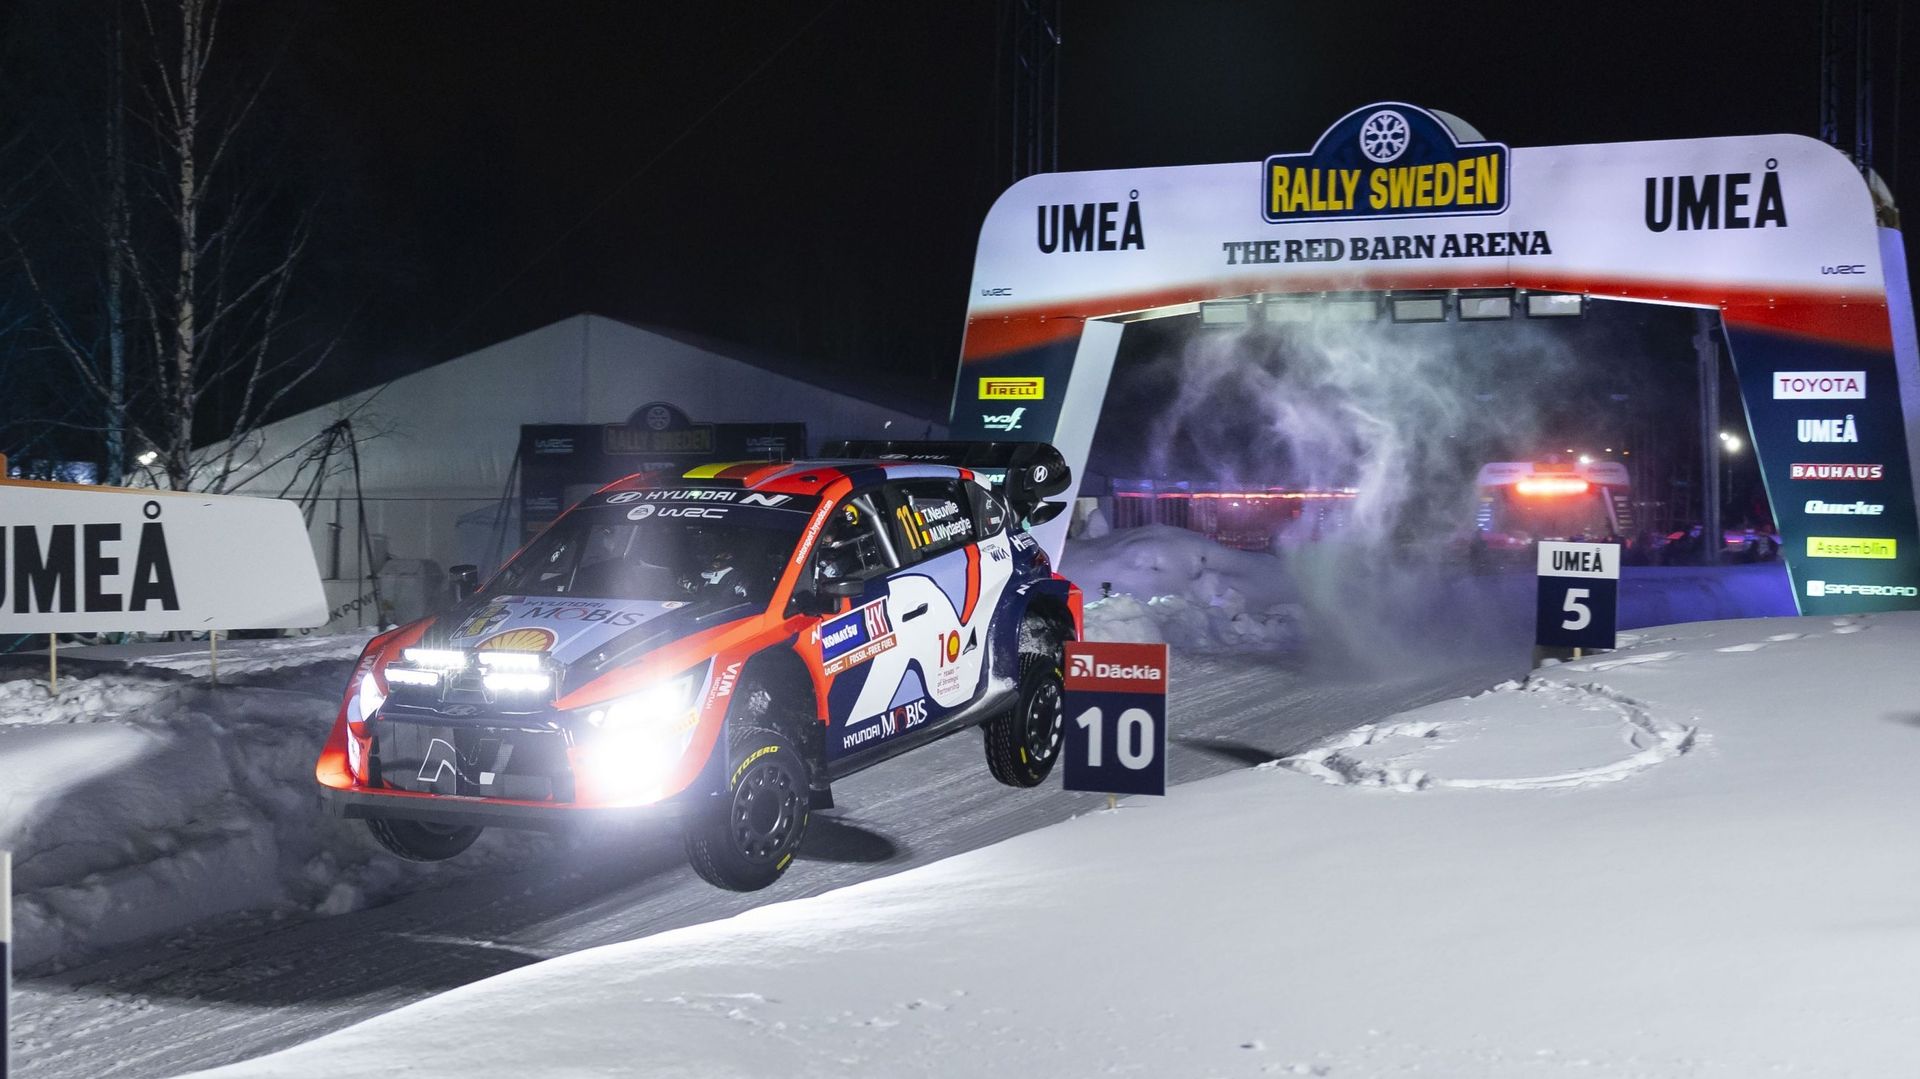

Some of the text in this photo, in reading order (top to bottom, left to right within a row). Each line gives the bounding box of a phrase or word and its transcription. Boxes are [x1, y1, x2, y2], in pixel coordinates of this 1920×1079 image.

[1272, 154, 1499, 213] RALLY SWEDEN
[1645, 157, 1788, 233] UMEÅ
[1037, 189, 1145, 254] UMEÅ
[1223, 230, 1552, 265] THE RED BARN ARENA
[1821, 264, 1867, 274] WRC
[981, 288, 1012, 297] WRC
[986, 382, 1037, 395] PIRELLI
[1780, 378, 1859, 392] TOYOTA
[1797, 414, 1858, 442] UMEÅ
[1791, 465, 1883, 479] BAUHAUS
[645, 490, 737, 501] HYUNDAI
[1805, 500, 1884, 515] Quicke
[657, 507, 729, 519] WRC
[896, 505, 922, 550] 11
[0, 500, 180, 614] MEÅ
[1552, 547, 1604, 573] UMEÅ
[1815, 542, 1889, 555] Assemblin
[1824, 584, 1918, 597] SAFEROAD
[519, 607, 644, 627] MOBIS
[1561, 588, 1592, 631] 5
[822, 623, 858, 649] KOMATSU
[849, 644, 882, 666] FOSSIL-FREE
[880, 636, 895, 651] FUEL
[716, 662, 742, 697] WIA
[1096, 663, 1161, 680] Däckia
[843, 699, 928, 750] HYUNDAI MOBIS
[1076, 706, 1154, 770] 10
